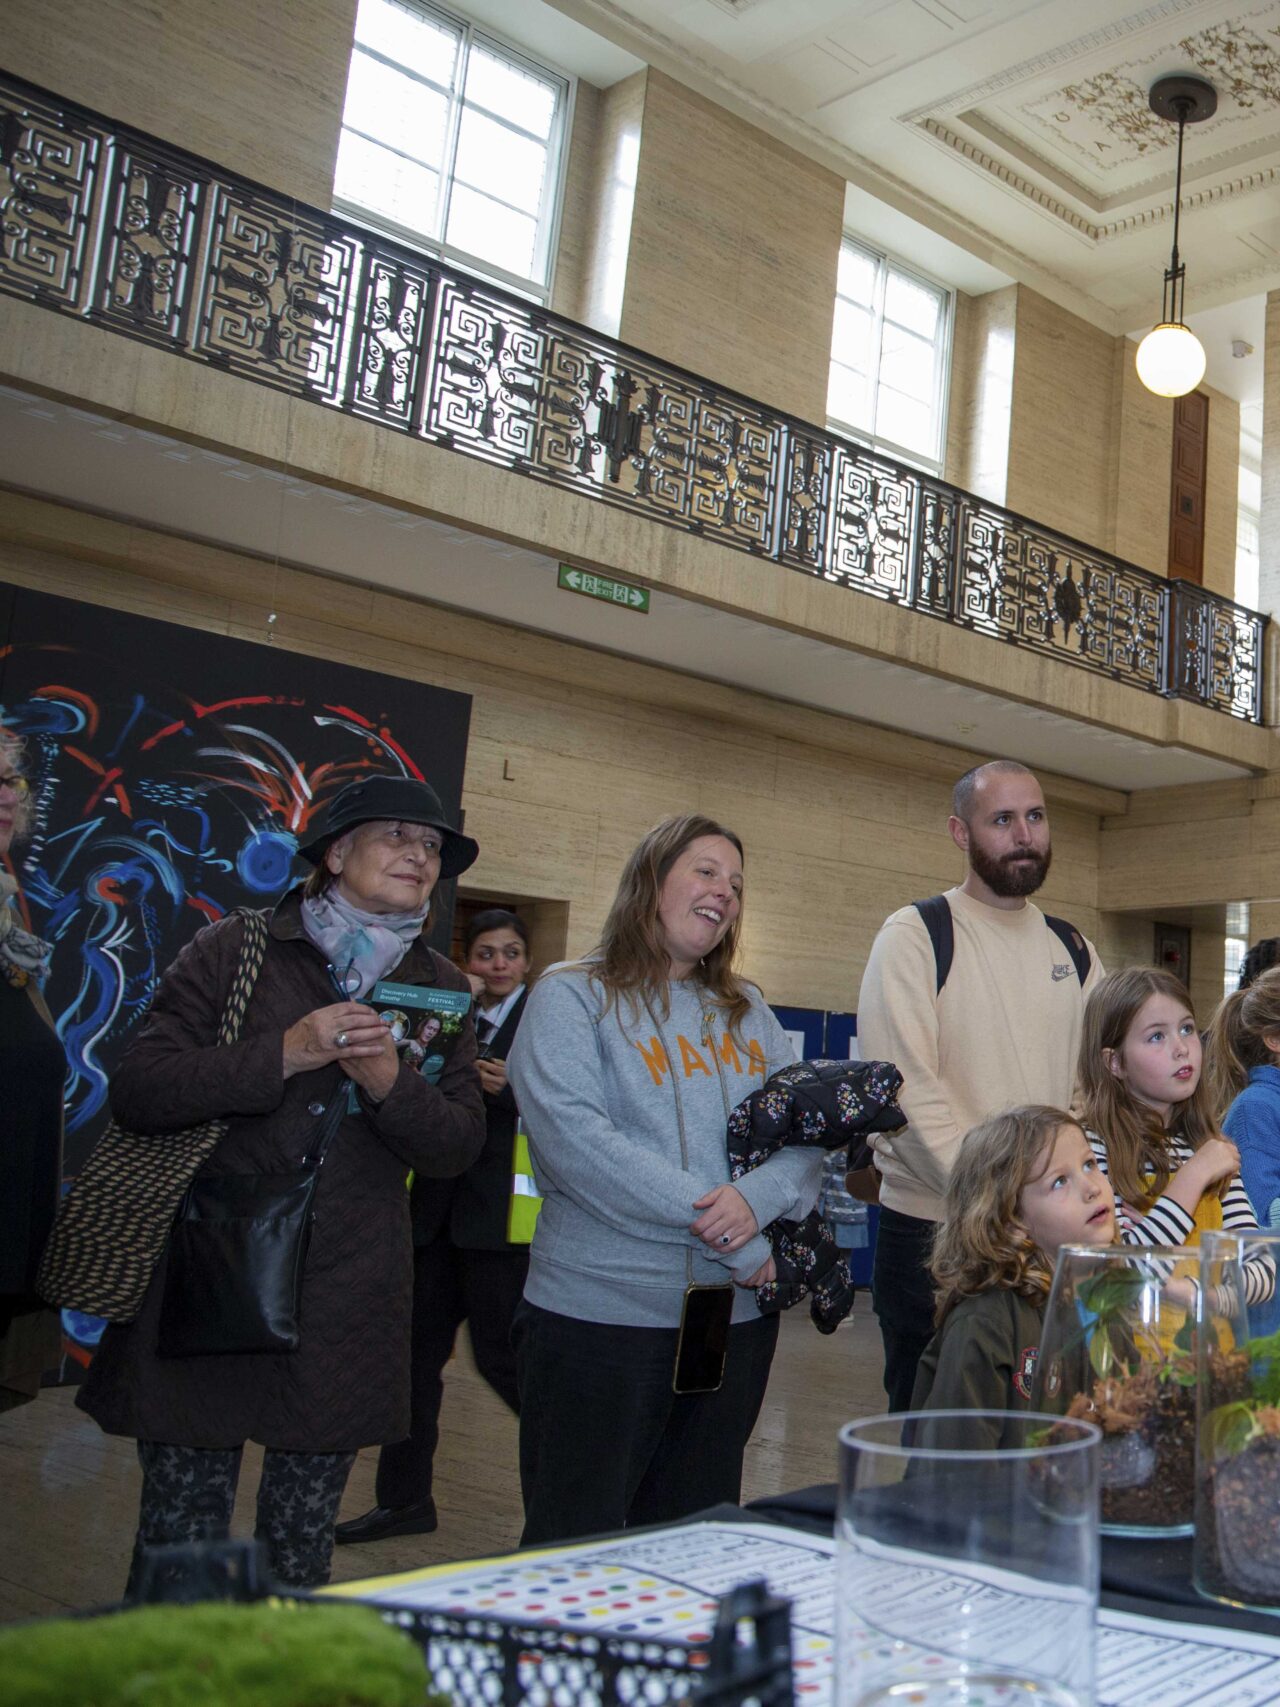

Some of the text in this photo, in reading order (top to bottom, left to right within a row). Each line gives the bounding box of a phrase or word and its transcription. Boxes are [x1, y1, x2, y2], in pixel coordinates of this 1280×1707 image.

[381, 988, 406, 998] Discovery
[427, 997, 455, 1005] FESTIVAL
[635, 1032, 768, 1087] MAMA
